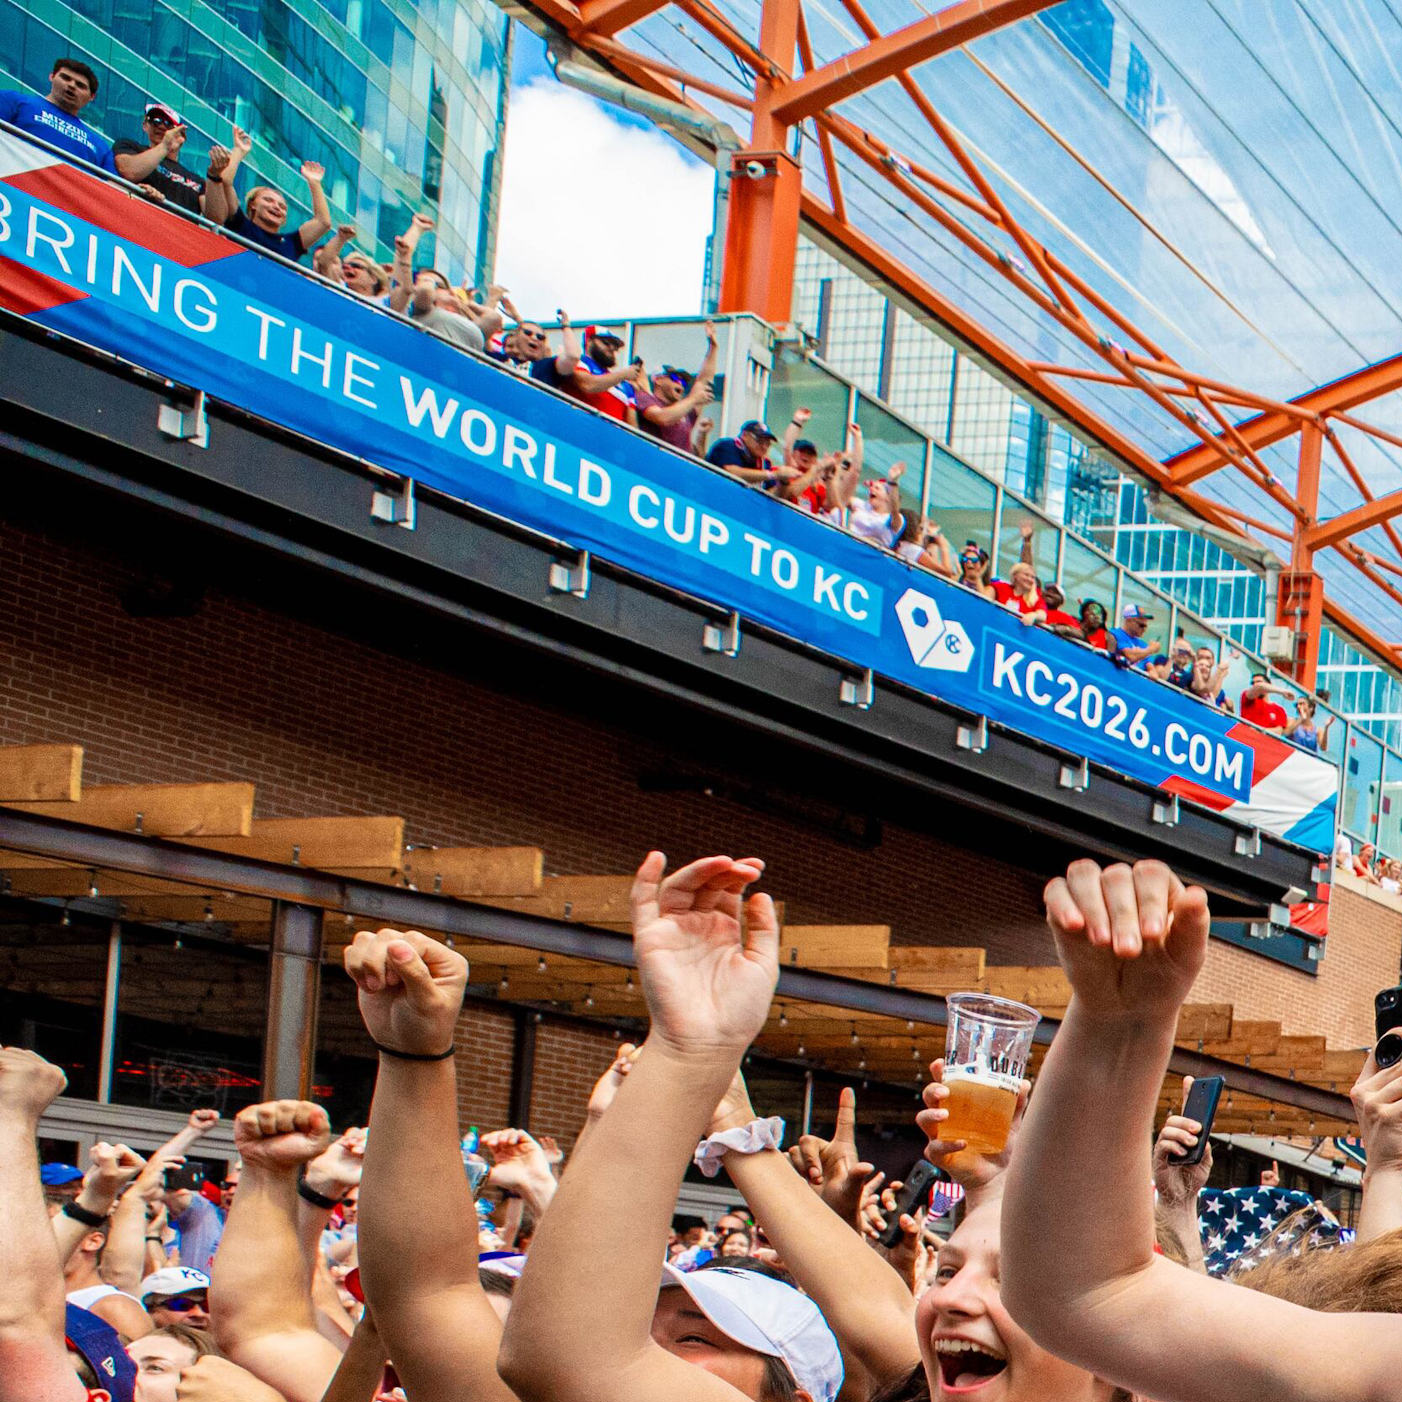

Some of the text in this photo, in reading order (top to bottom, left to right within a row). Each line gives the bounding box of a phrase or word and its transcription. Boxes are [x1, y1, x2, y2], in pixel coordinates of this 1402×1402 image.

[41, 110, 88, 139] MIZZOU
[246, 305, 381, 409] THE
[400, 375, 611, 507] WORLD
[628, 484, 730, 553] CUP
[744, 532, 799, 590] TO
[813, 565, 870, 621] KC
[992, 642, 1244, 791] KC2026.COM
